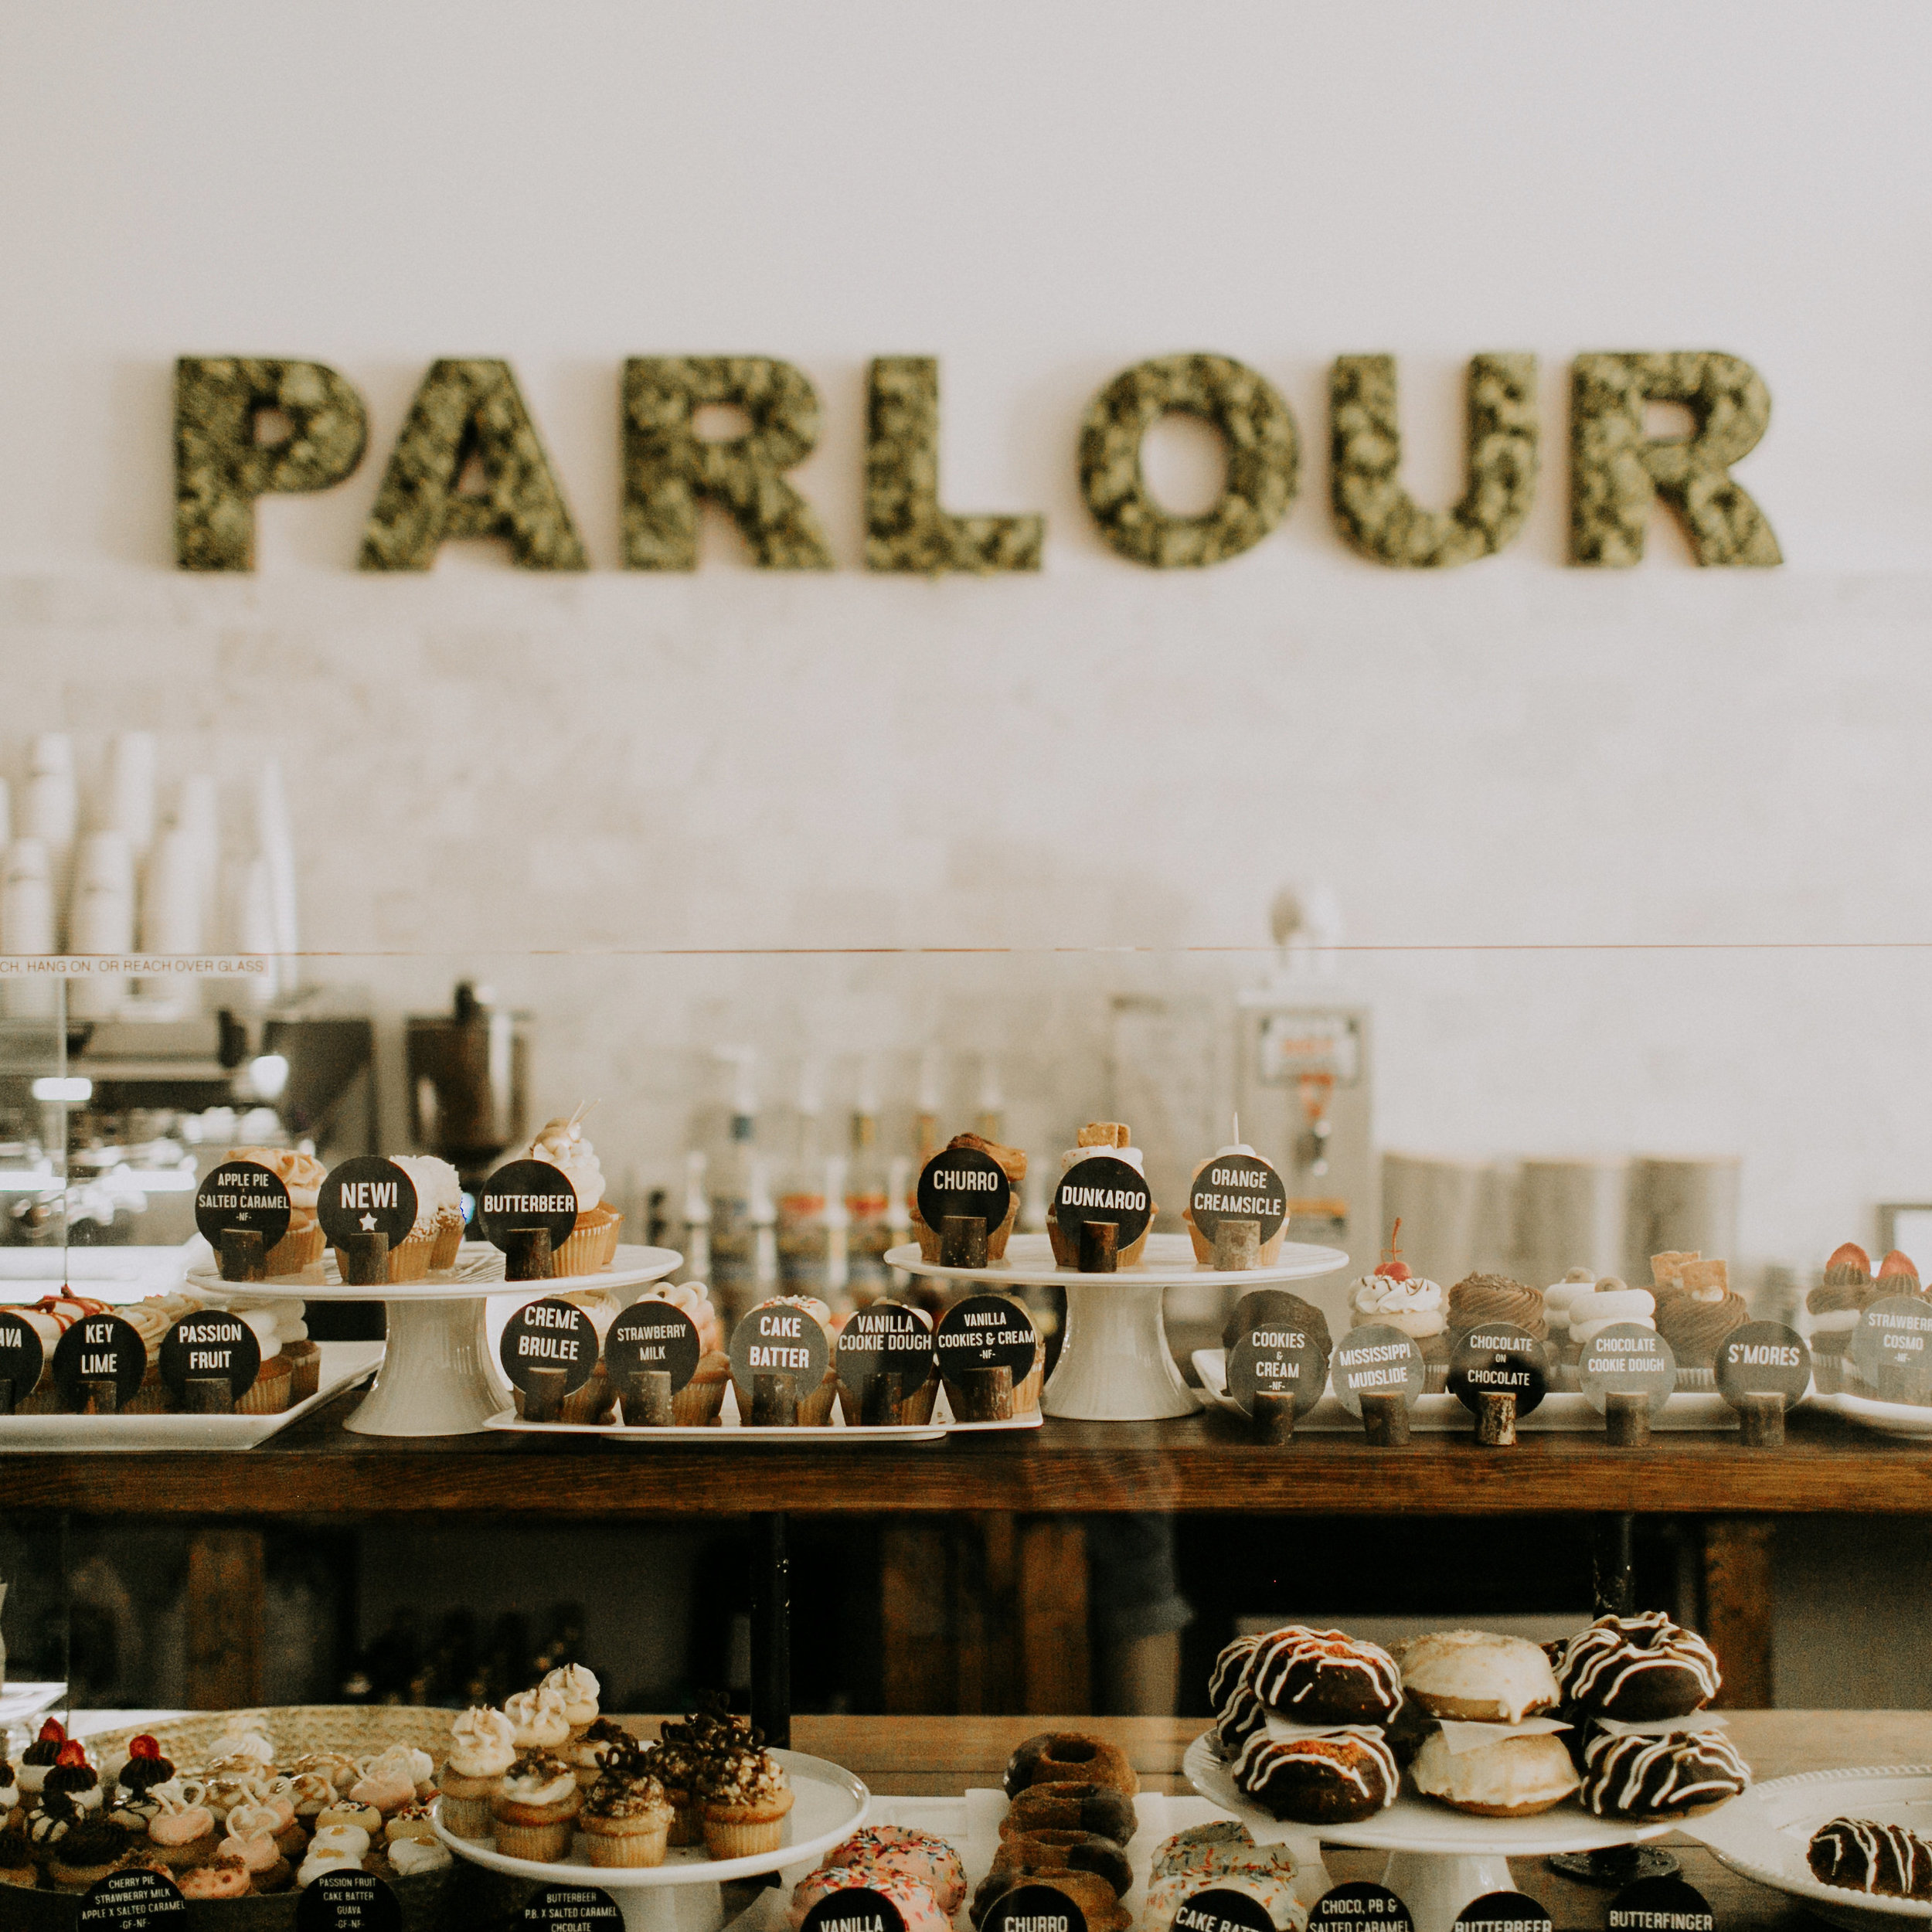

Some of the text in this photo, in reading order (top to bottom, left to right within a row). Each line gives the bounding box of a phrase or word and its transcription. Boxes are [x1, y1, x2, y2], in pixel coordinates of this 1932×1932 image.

[175, 352, 1784, 573] PARLOUR
[27, 960, 66, 972] HANG
[99, 960, 119, 972] OR
[124, 960, 171, 972] REACH
[175, 960, 214, 972] OVER
[218, 960, 264, 972] GLASS
[218, 1172, 269, 1187] APPLE PIE
[933, 1170, 998, 1192] CHURRO
[1211, 1168, 1267, 1189] ORANGE
[199, 1194, 290, 1209] SALTED CARAMEL
[341, 1182, 398, 1209] NEW!
[483, 1194, 576, 1213] BUTTERBEER
[1061, 1185, 1147, 1212] DUNKAROO
[1194, 1192, 1281, 1216] CREAMSICLE
[524, 1305, 580, 1331] CREME
[760, 1315, 801, 1338] CAKE
[857, 1315, 914, 1333] VANILLA
[964, 1311, 1006, 1327] VANILLA
[85, 1324, 114, 1344] KEY
[179, 1324, 242, 1344] PASSION
[617, 1324, 686, 1342] STRAWBERRY
[938, 1330, 1035, 1348] COOKIES & CREAM
[1252, 1332, 1305, 1349] COOKIES
[518, 1335, 580, 1361] BRULEE
[838, 1334, 932, 1351] COOKIE DOUGH
[1470, 1334, 1532, 1352] CHOCOLATE
[1596, 1338, 1656, 1352] CHOCOLATE
[1883, 1334, 1923, 1351] COSMO
[190, 1350, 232, 1369] FRUIT
[639, 1345, 665, 1361] MILK
[749, 1345, 809, 1369] BATTER
[1276, 1351, 1284, 1361] &
[1339, 1343, 1411, 1366] MISSISSIPPI
[1495, 1353, 1506, 1363] ON
[81, 1353, 117, 1374] LIME
[1256, 1361, 1300, 1378] CREAM
[1588, 1358, 1665, 1372] COOKIE DOUGH
[1348, 1366, 1407, 1389] MUDSLIDE
[1468, 1369, 1530, 1386] CHOCOLATE
[108, 1875, 155, 1889] CHERRY PIE
[319, 1877, 376, 1887] PASSION FRUIT
[95, 1888, 170, 1905] STRAWBERRY MILK
[323, 1891, 374, 1901] CAKE BATTER
[546, 1892, 596, 1903] BUTTERBEER
[82, 1900, 185, 1920] APPLE X SALTED CARAMEL
[337, 1906, 362, 1915] GUAVA
[542, 1908, 546, 1918] X
[549, 1908, 578, 1918] SALTED
[580, 1906, 617, 1917] CARAMEL
[1322, 1898, 1397, 1915] CHOCO, PB &
[820, 1913, 884, 1932] VANILLA
[1004, 1915, 1068, 1932] CHURRO
[1175, 1906, 1217, 1932] CAKE
[1309, 1920, 1410, 1932] SALTED CARAMEL
[1610, 1910, 1713, 1931] BUTTERFINGER
